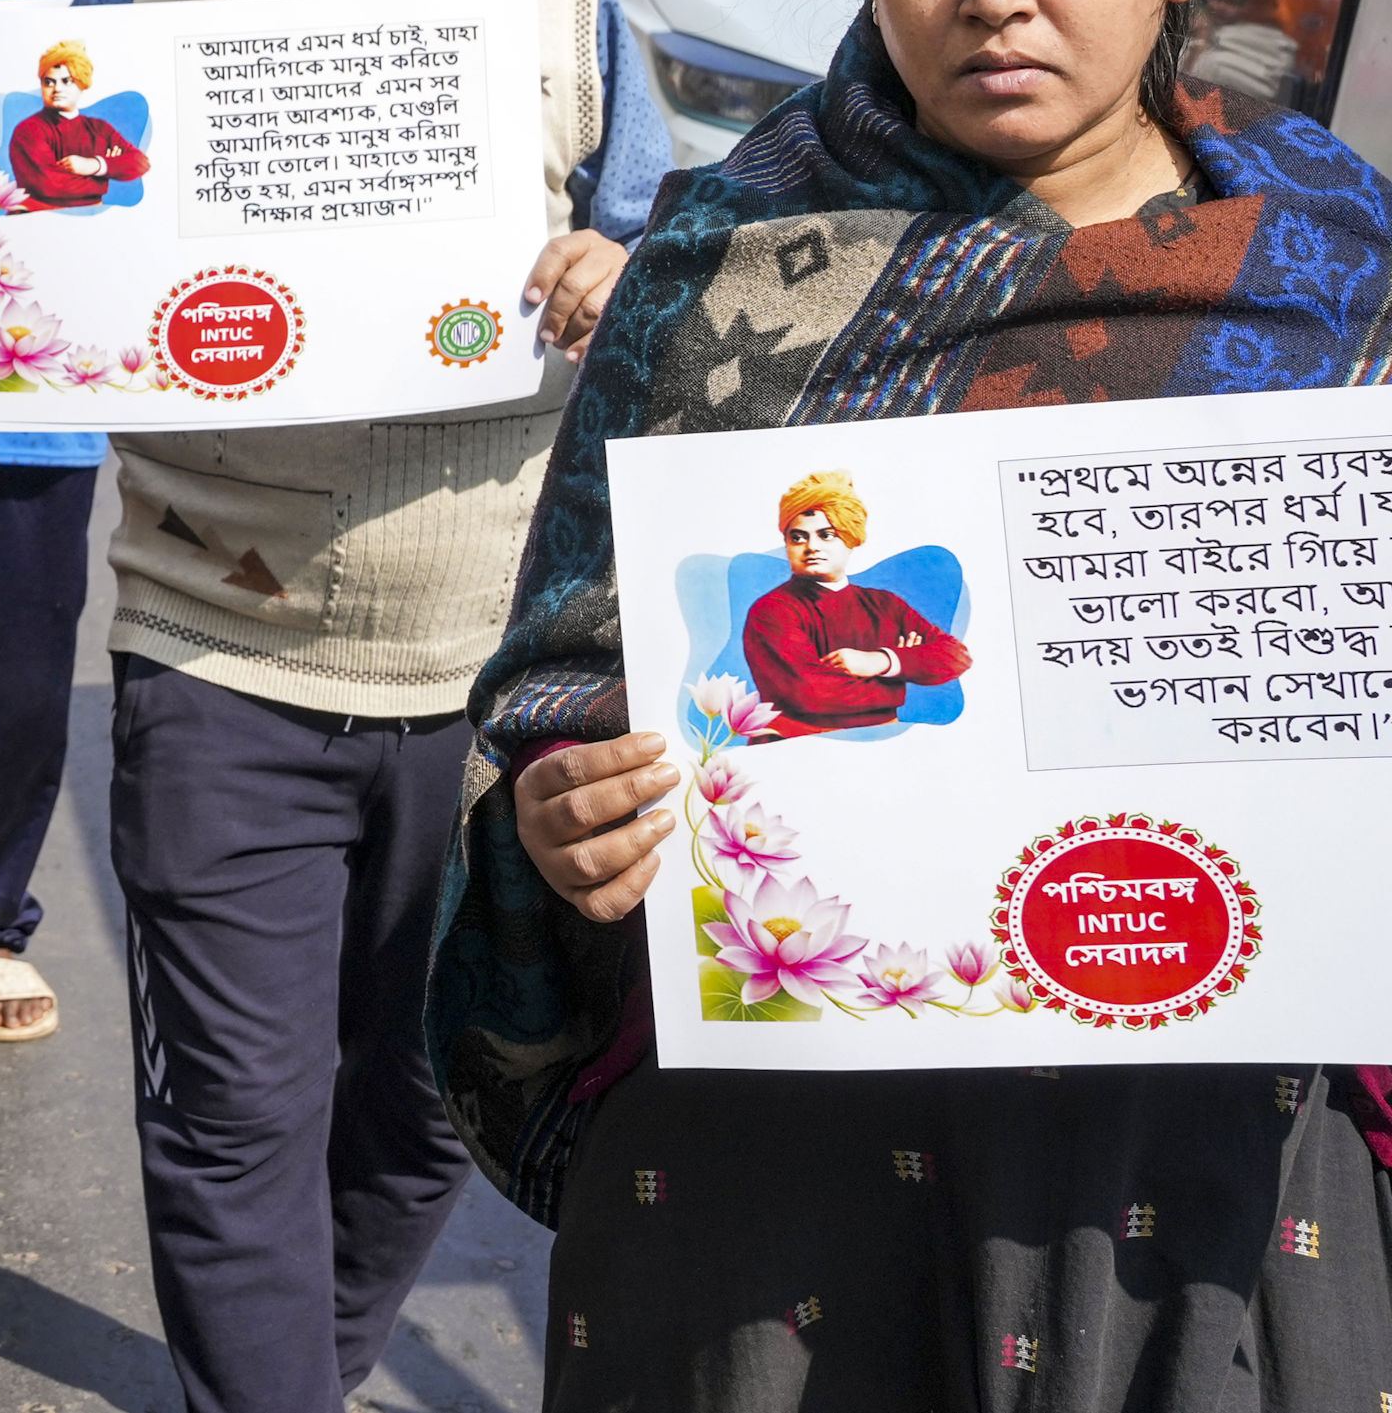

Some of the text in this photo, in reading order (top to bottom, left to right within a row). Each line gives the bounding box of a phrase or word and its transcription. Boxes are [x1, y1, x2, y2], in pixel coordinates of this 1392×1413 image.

[198, 24, 478, 56] আমাদের এমন ধর্ম চাই, যাহা
[203, 47, 458, 80] আমাদিগকে মানুষ করিতে
[206, 76, 459, 105] পারে। আমাদের এমন সব
[207, 94, 458, 130] মতবাদ আবশ্যক, যেগুলি
[208, 120, 460, 153] আমাদিগকে মানুষ করিয়া
[195, 146, 476, 183] গড়িয়া তোলে। যাহাতে মানুষ
[196, 180, 251, 203] গঠিত
[258, 183, 294, 199] হয়,
[304, 179, 352, 196] এমন
[242, 203, 313, 224] শিক্ষার
[181, 302, 273, 323] পশ্চিমবঙ্গ
[201, 327, 252, 342] INTUC
[191, 345, 264, 363] সেবাদল
[1163, 455, 1286, 486] অন্নের
[1032, 481, 1346, 538] হবে, তারপর ধর্ম
[1023, 531, 1378, 582] আমরা বাইরে গিয়ে
[1069, 585, 1328, 623] ভালো করবো,
[1037, 620, 1379, 668] হৃদয় ততই বিশুদ্ধ
[1110, 675, 1251, 708] ভগবান
[1042, 872, 1198, 903] পশ্চিমবঙ্গ
[1079, 912, 1166, 933] INTUC
[1066, 942, 1188, 966] সেবাদল
